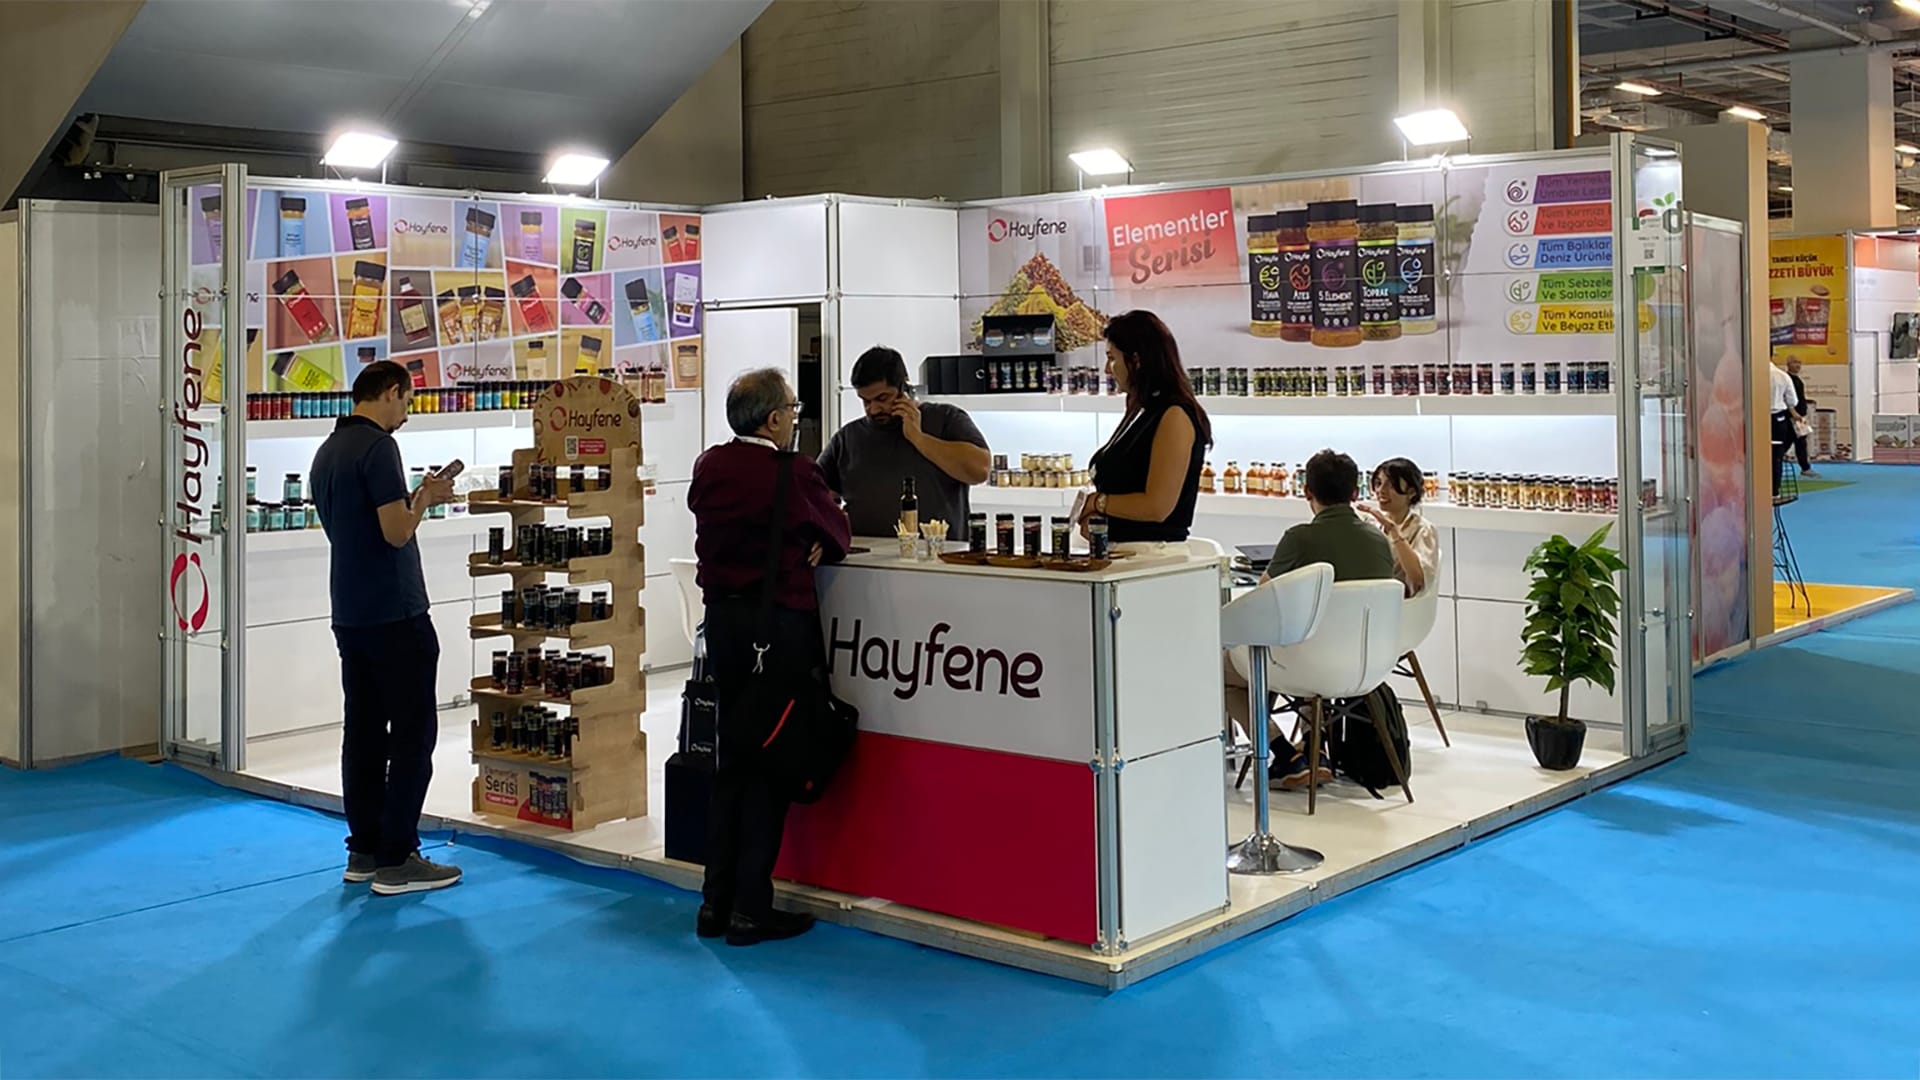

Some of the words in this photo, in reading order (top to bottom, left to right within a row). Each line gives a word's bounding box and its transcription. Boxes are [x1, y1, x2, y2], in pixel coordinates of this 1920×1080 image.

[408, 221, 448, 236] Hayfene
[1009, 218, 1067, 240] Hayfene
[1113, 209, 1229, 248] Elementler
[621, 237, 657, 250] Hayfene
[1542, 241, 1564, 251] Tüm
[1129, 231, 1216, 285] Serisi
[1541, 253, 1571, 263] Deniz
[1574, 251, 1612, 262] Ürünle
[1769, 265, 1796, 279] ZZETİ
[1798, 263, 1834, 278] BÜYÜK
[1542, 278, 1566, 289] Tüm
[1568, 276, 1612, 288] Sebzele
[1542, 290, 1556, 299] Ve
[1559, 286, 1612, 299] Salatalar
[1543, 309, 1565, 320] Tüm
[1542, 321, 1556, 330] Ve
[1560, 321, 1594, 333] Beyaz
[463, 364, 508, 379] Hayfene
[174, 308, 209, 544] Hayfene
[568, 408, 621, 432] Hayfene
[829, 617, 1043, 700] Hayfene
[485, 774, 518, 795] Serisi
